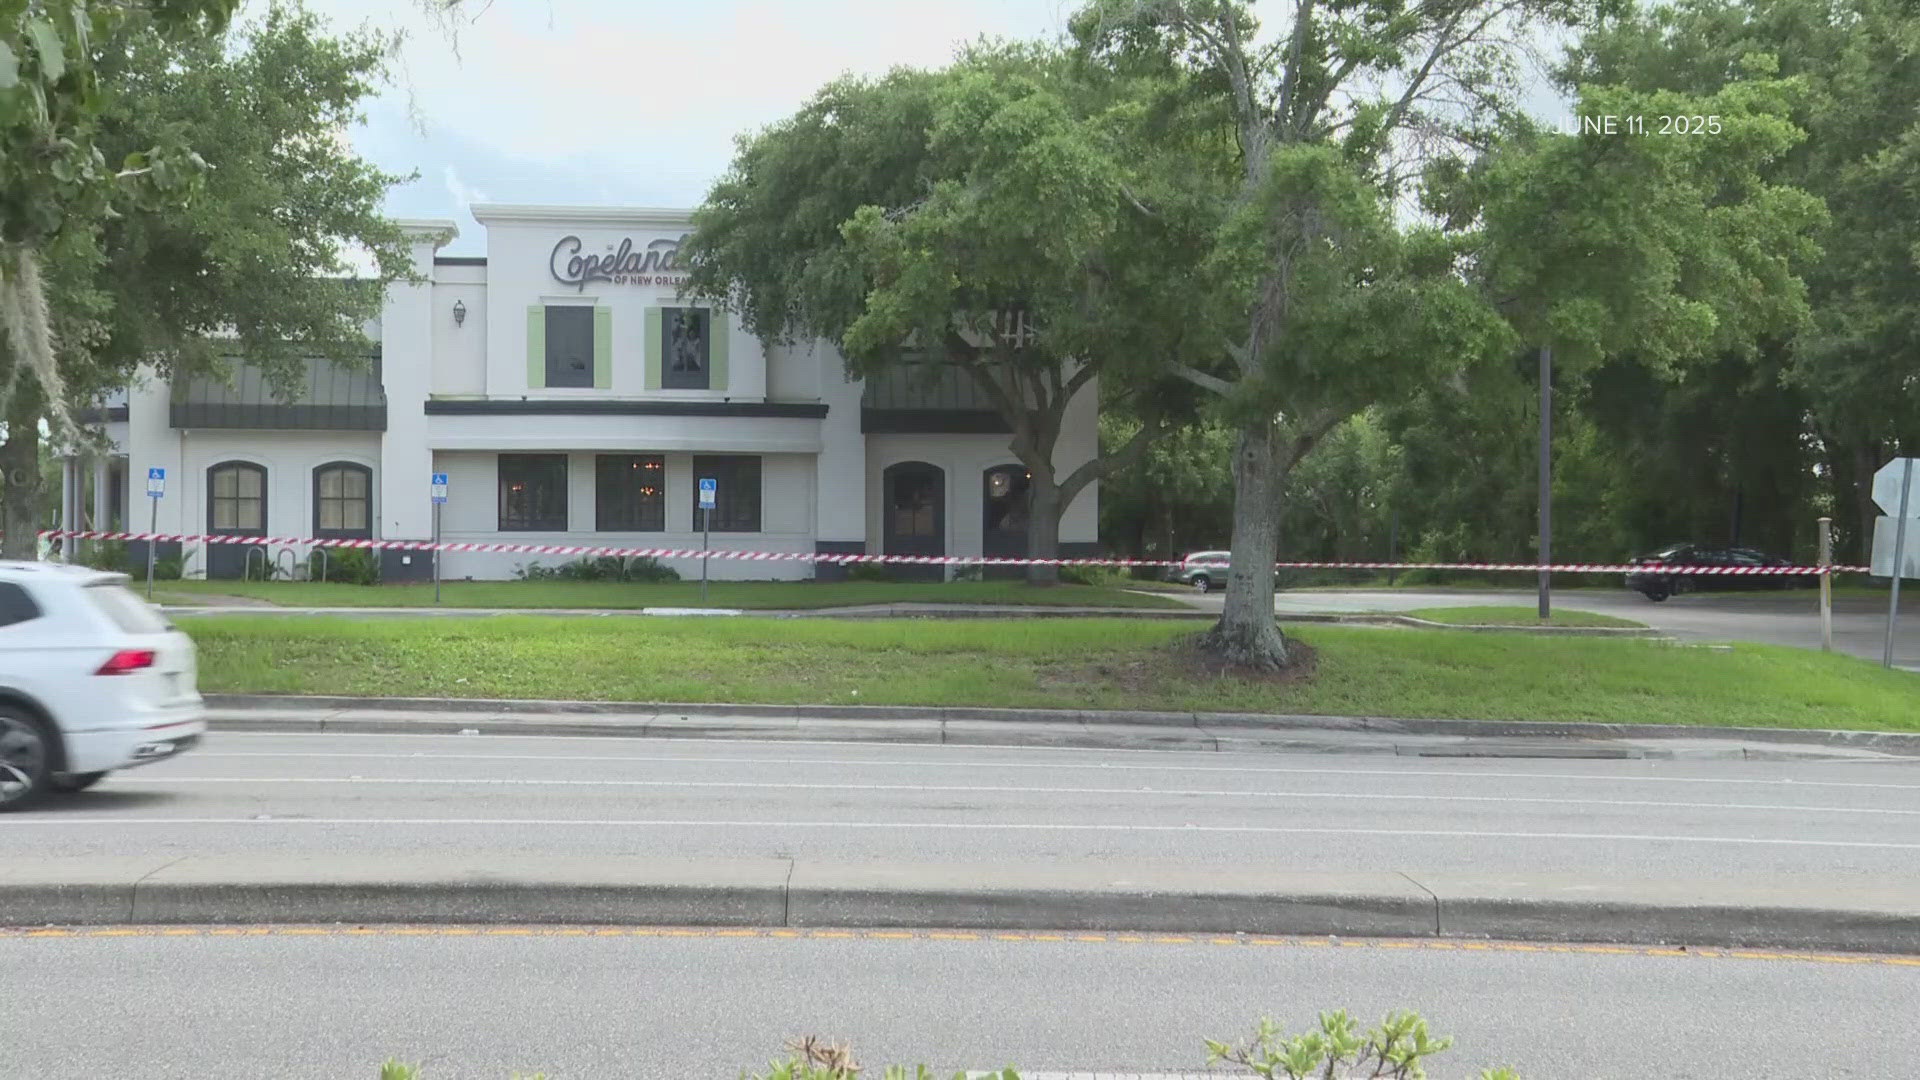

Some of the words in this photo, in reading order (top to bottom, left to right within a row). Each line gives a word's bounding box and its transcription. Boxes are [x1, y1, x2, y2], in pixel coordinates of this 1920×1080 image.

[550, 234, 690, 293] Copeland
[614, 275, 628, 286] OF
[630, 275, 653, 286] NEW
[655, 275, 691, 286] ORLEA
